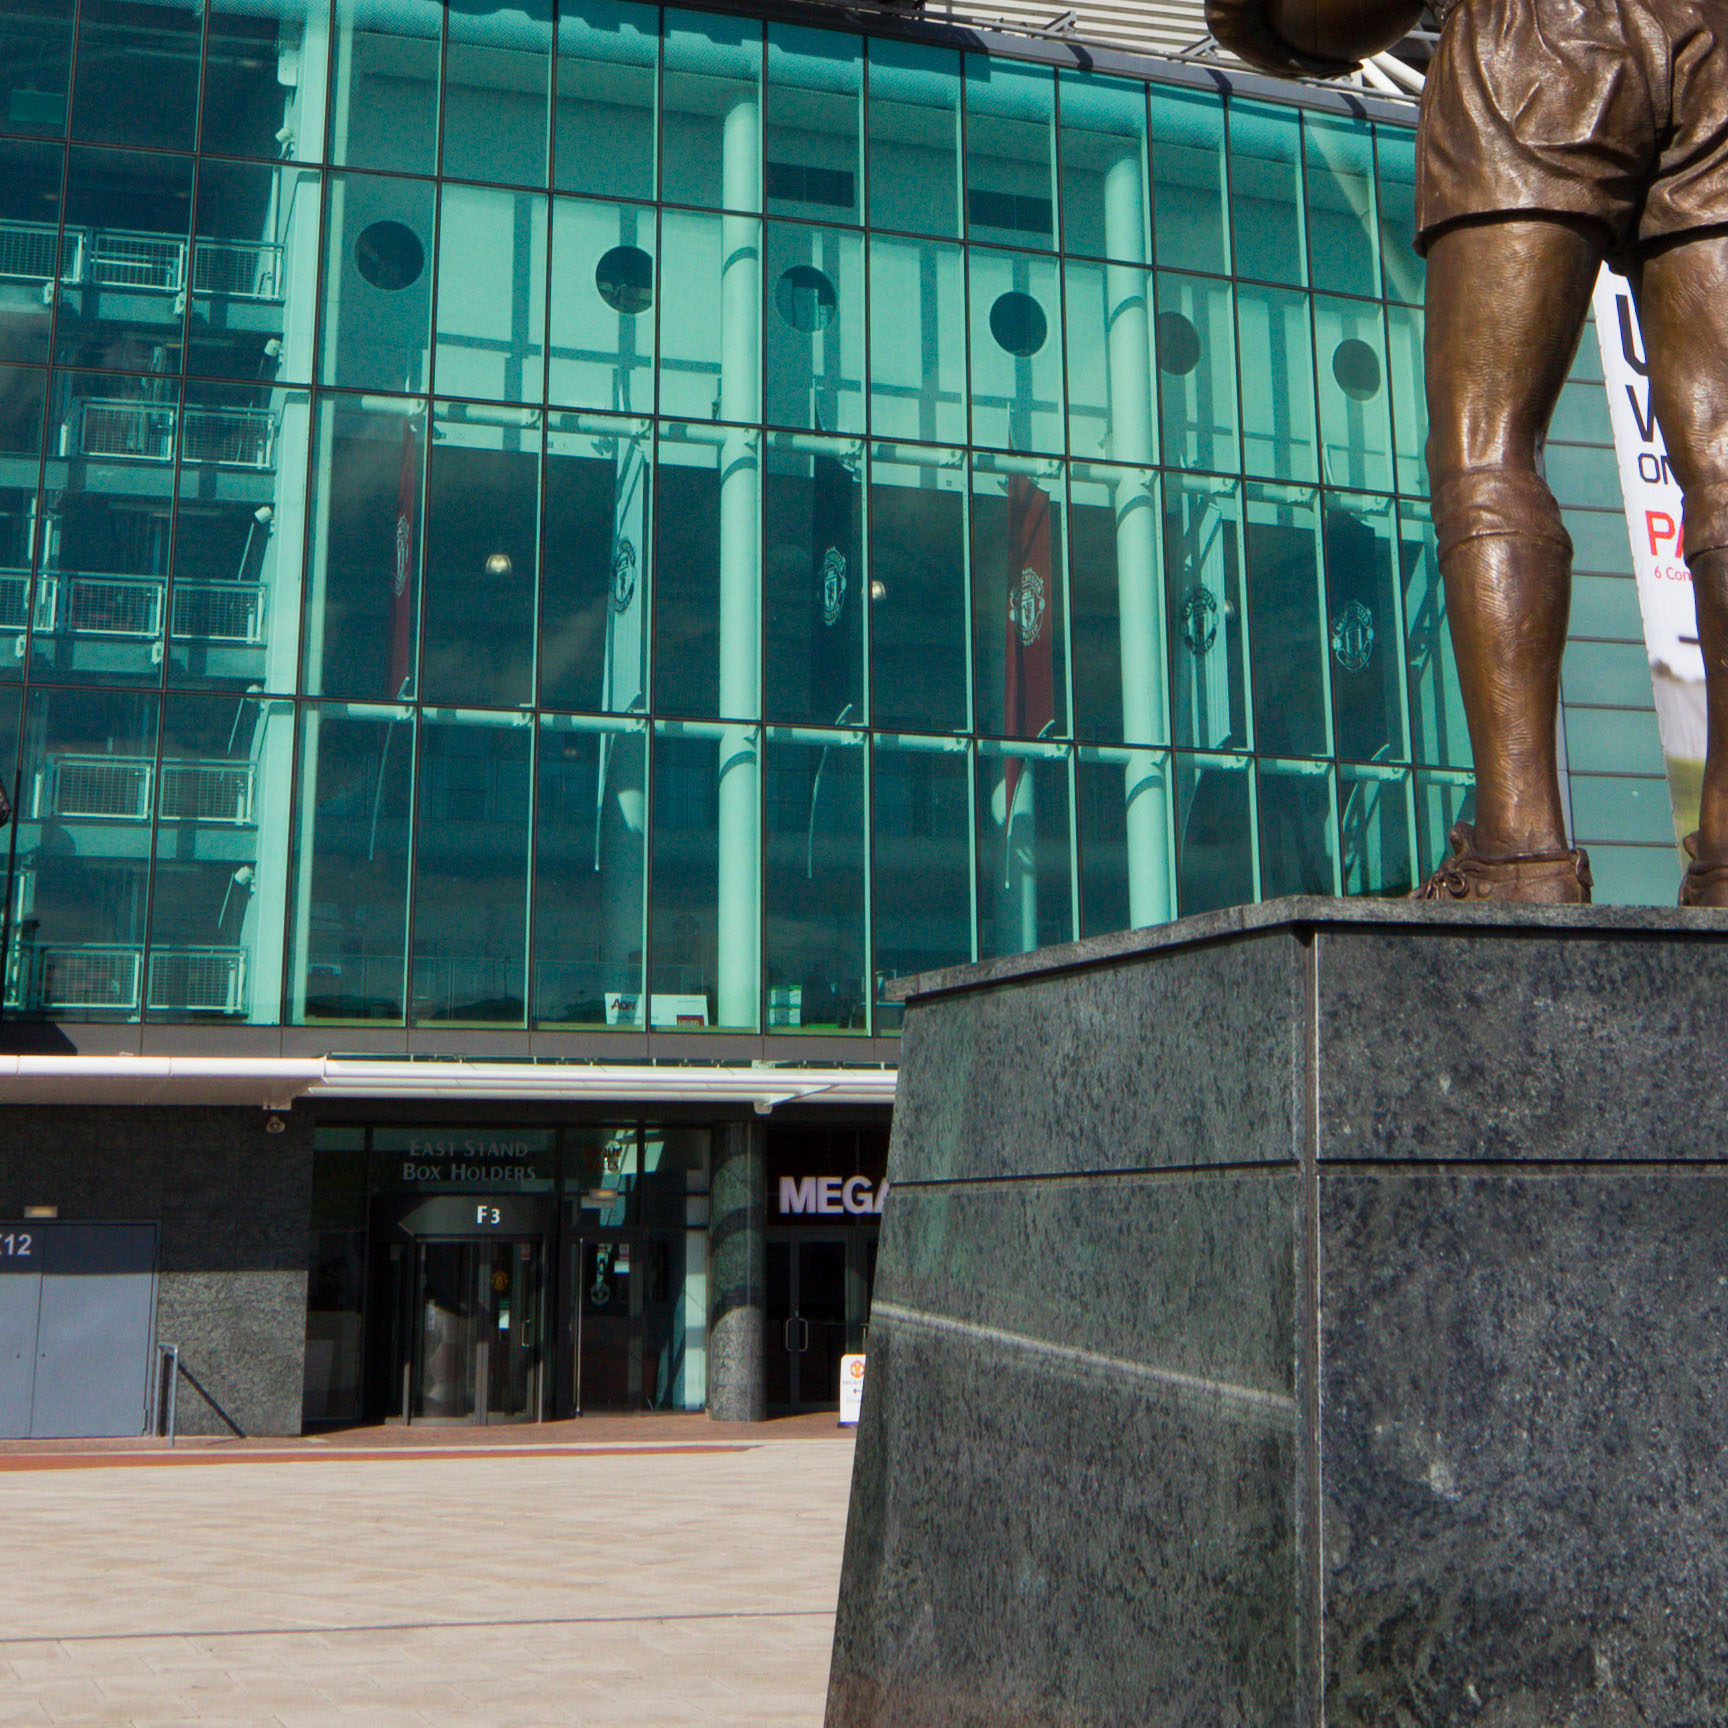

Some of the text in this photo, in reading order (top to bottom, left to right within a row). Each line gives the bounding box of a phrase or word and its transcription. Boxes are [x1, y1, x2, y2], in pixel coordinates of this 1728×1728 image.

[1654, 565, 1663, 579] 6
[409, 1139, 529, 1158] EAST STAND
[403, 1162, 537, 1182] BOX HOLDERS
